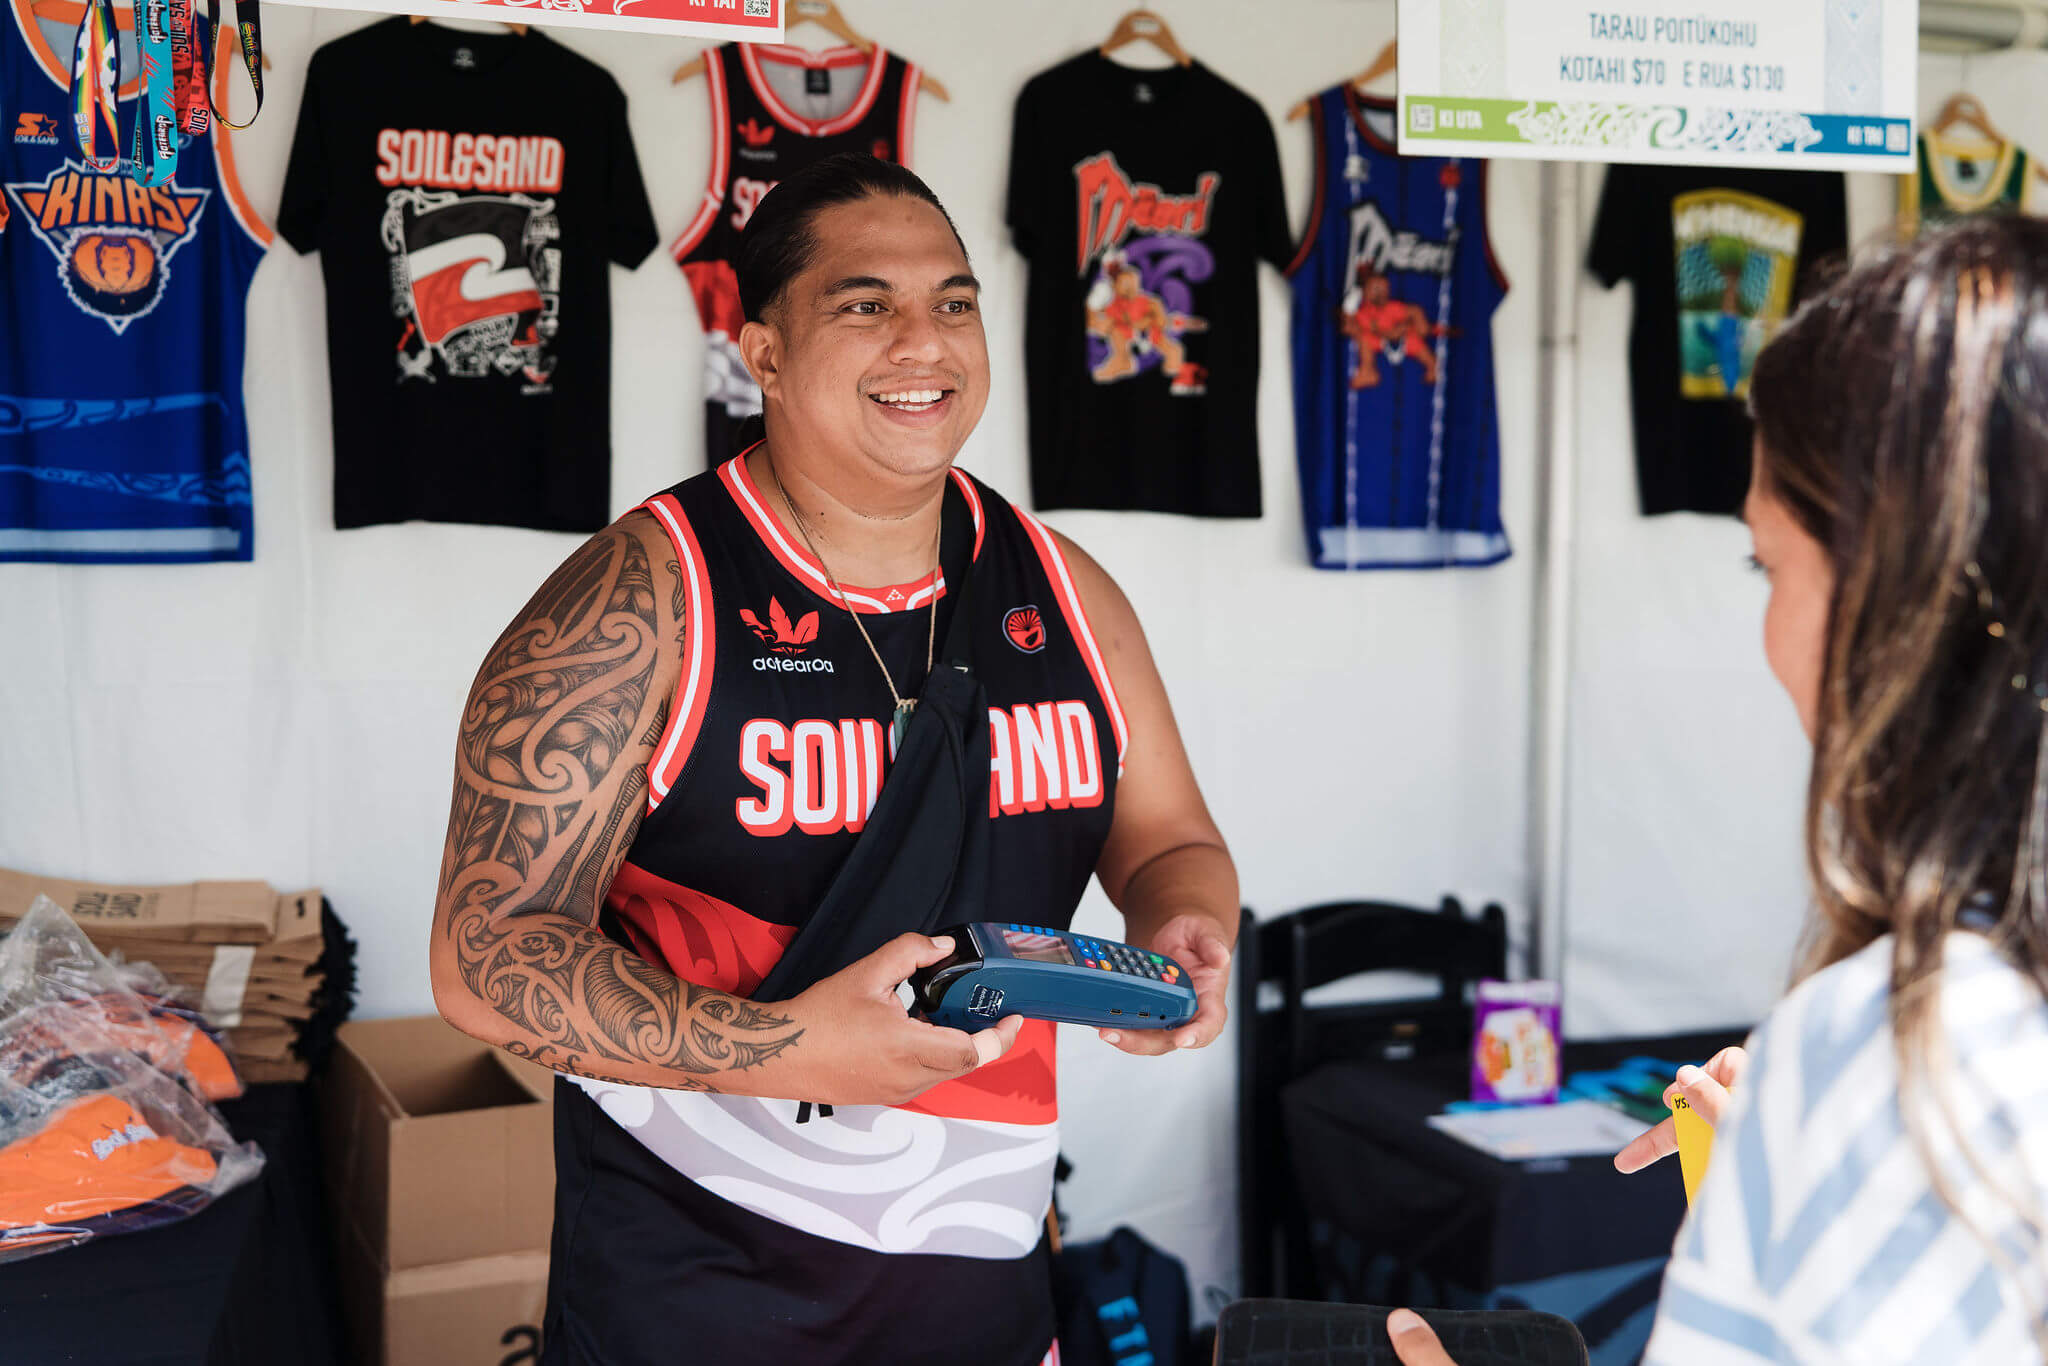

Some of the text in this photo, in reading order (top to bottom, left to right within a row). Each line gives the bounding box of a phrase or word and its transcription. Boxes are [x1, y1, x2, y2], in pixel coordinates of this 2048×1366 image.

[169, 0, 185, 18] SA
[1589, 12, 1647, 42] TARAU
[1560, 55, 1785, 92] KOTAHI $70 E RUA $130
[40, 171, 187, 235] KINAS
[752, 657, 834, 673] aotearoa
